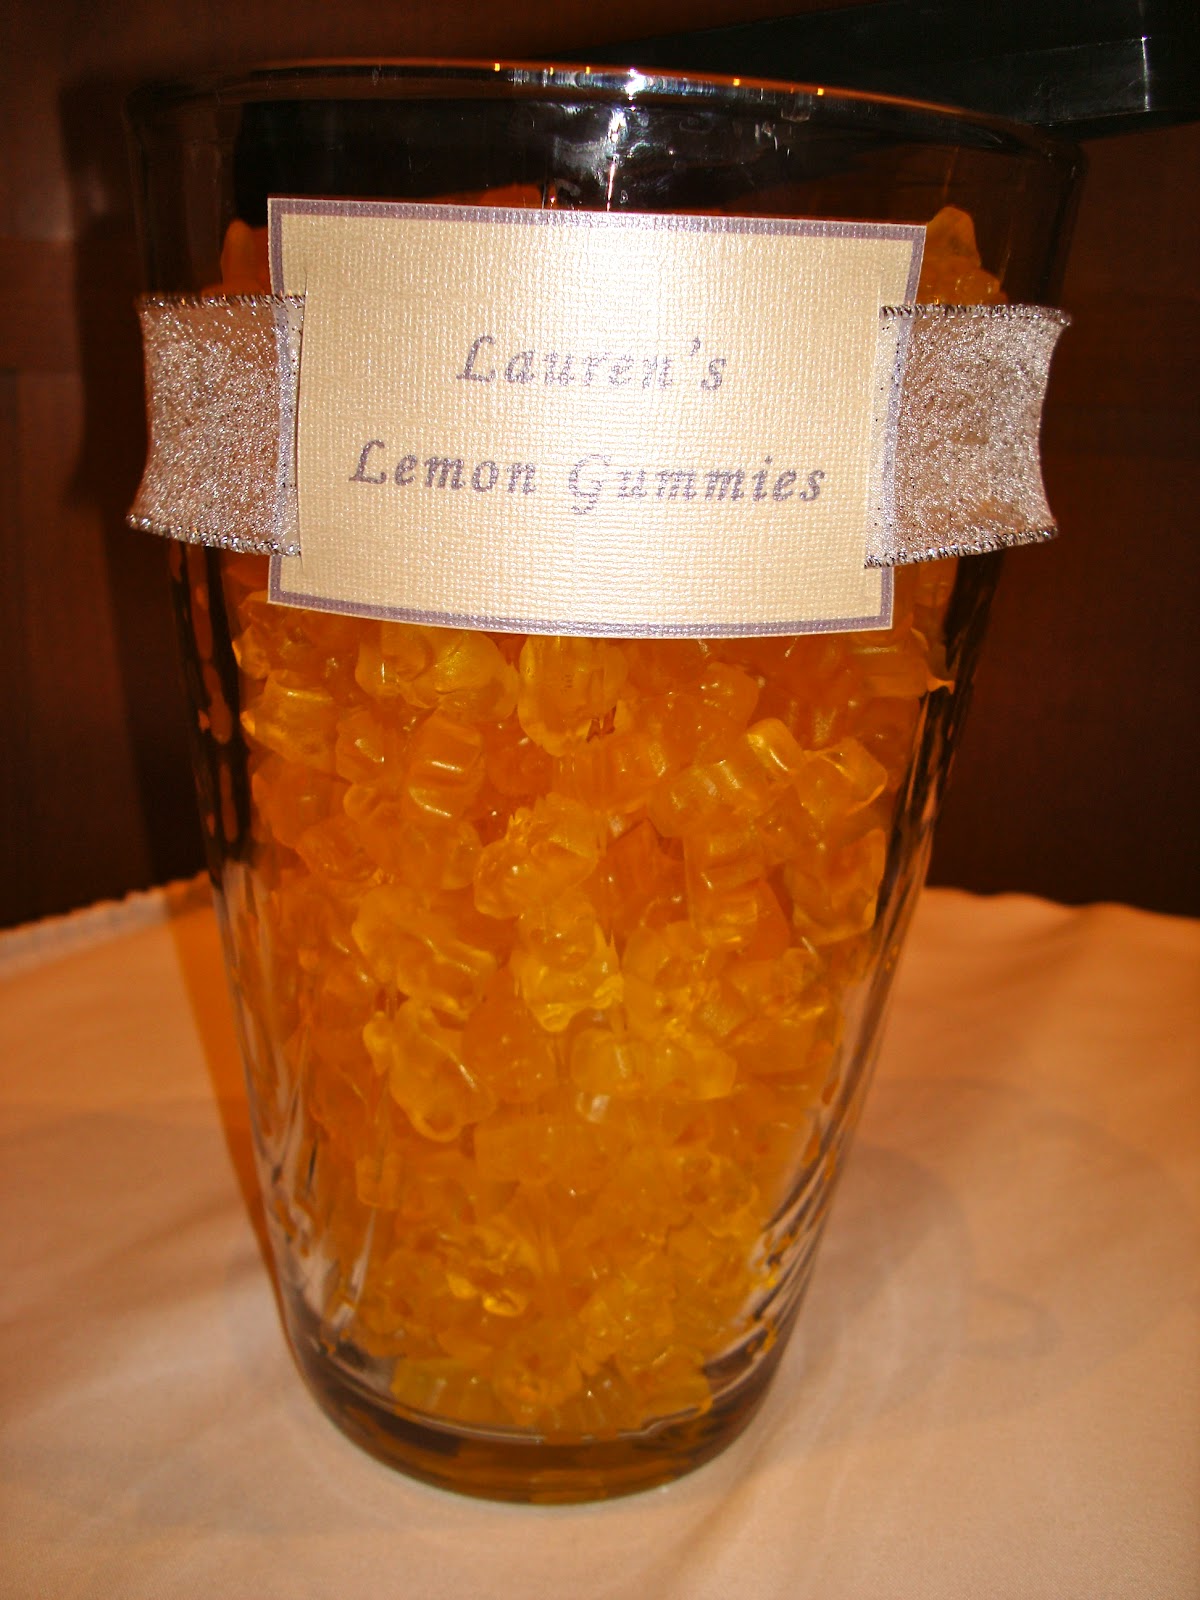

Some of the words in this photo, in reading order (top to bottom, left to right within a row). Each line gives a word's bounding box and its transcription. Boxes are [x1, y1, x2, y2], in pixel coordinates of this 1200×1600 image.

[456, 335, 728, 391] Lauren's
[348, 439, 538, 497] Lemon
[568, 453, 826, 516] Gummies
